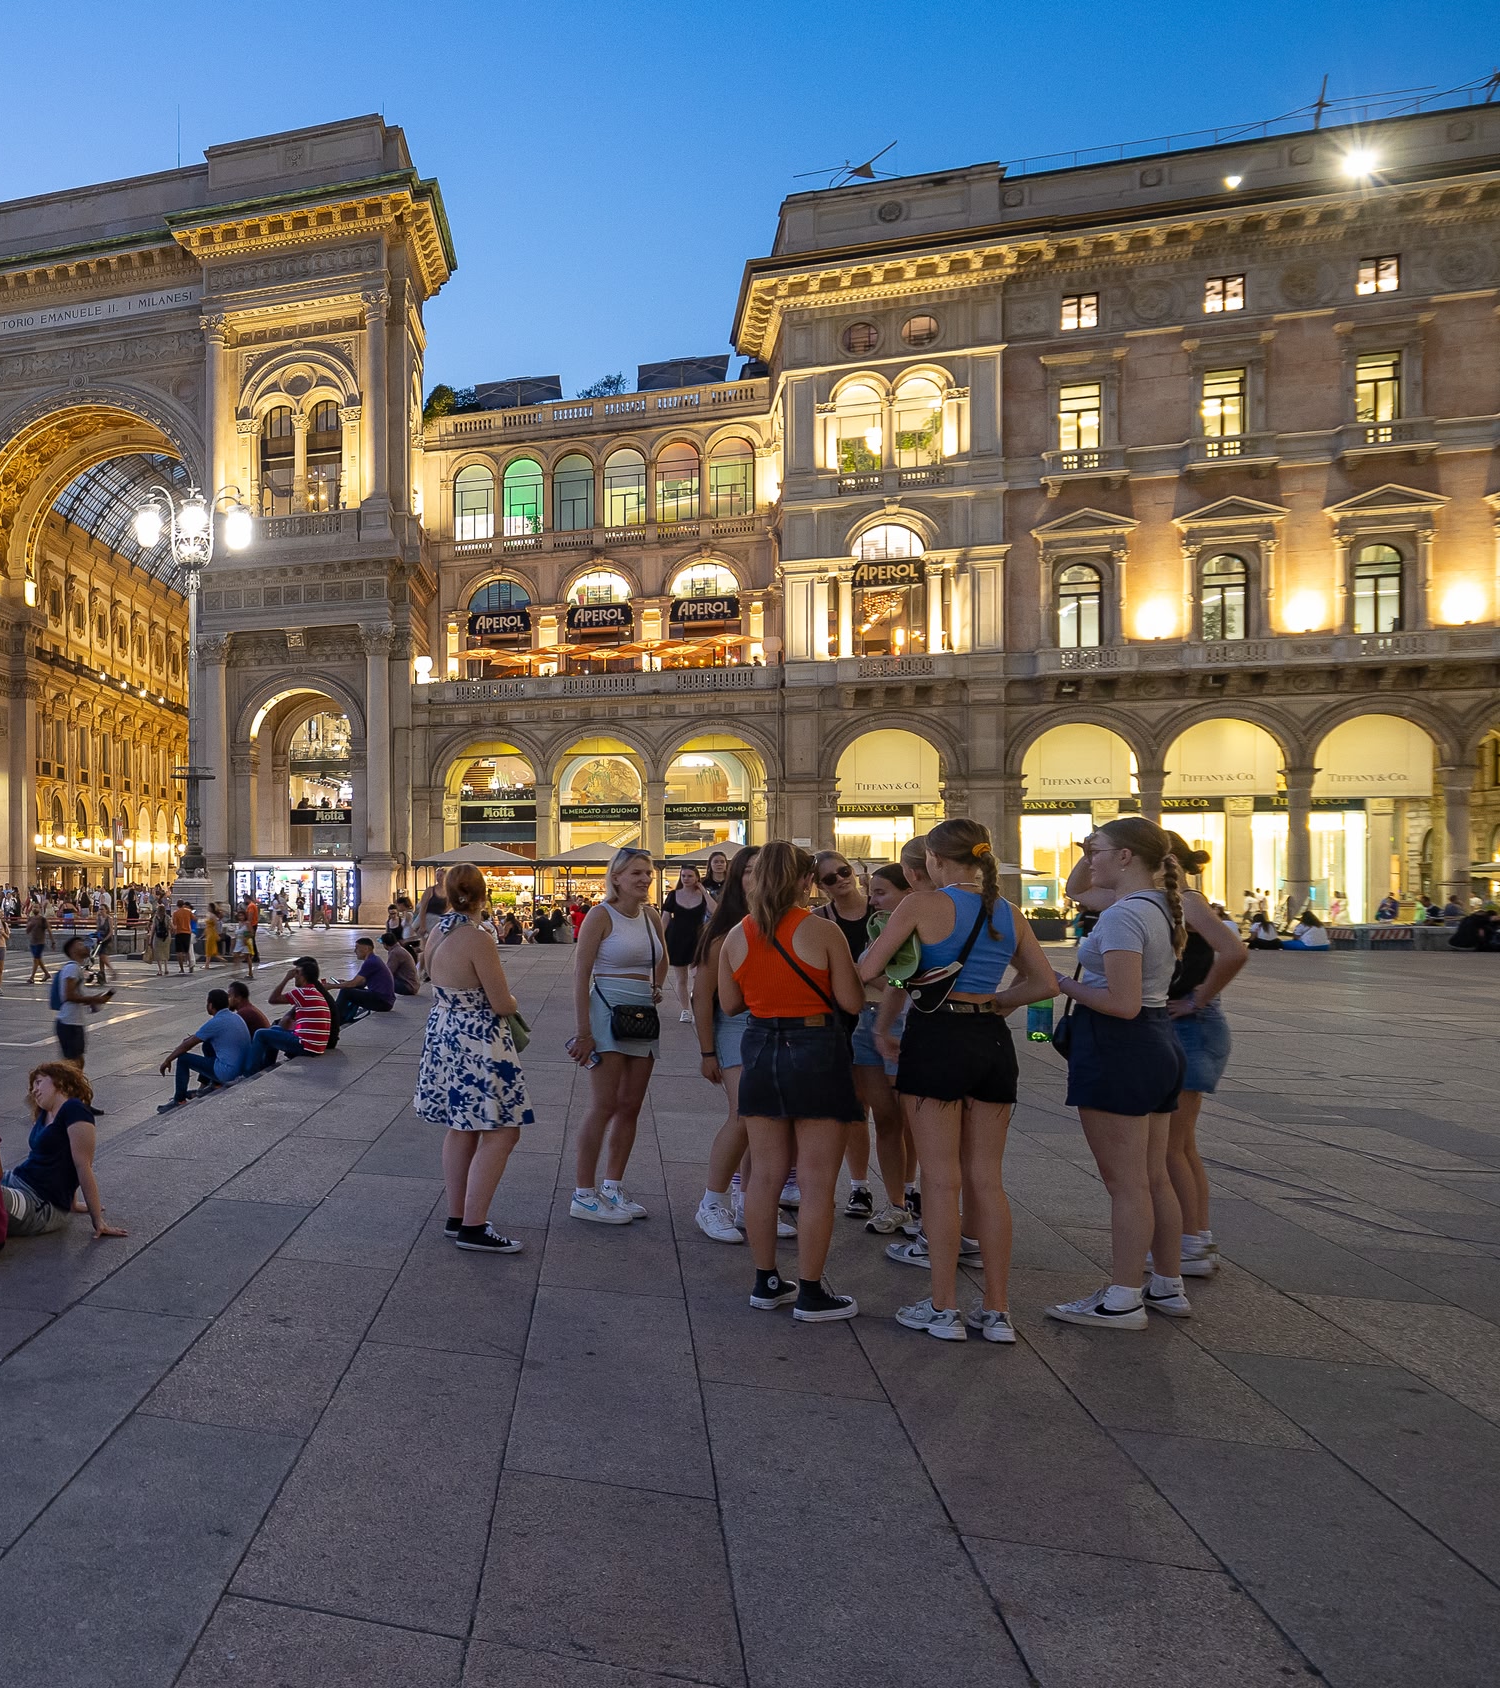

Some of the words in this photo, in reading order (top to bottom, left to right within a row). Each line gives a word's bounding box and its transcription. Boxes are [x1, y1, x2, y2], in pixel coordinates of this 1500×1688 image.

[40, 305, 102, 324] EMANUELE
[138, 291, 193, 309] MILANESI
[856, 564, 918, 580] APEROL
[855, 578, 919, 586] TERRAZZA
[678, 602, 732, 616] APEROL
[574, 608, 624, 622] APEROL
[475, 616, 524, 630] APEROL
[574, 620, 625, 628] TERRAZZA
[476, 626, 524, 634] TERRAZZA
[1040, 778, 1082, 786] TIFFANY
[1180, 774, 1225, 782] TIFFANY
[1328, 773, 1376, 782] TIFFANY
[855, 782, 894, 790] TIFFANY
[316, 810, 345, 820] Motta
[482, 806, 515, 818] Motta
